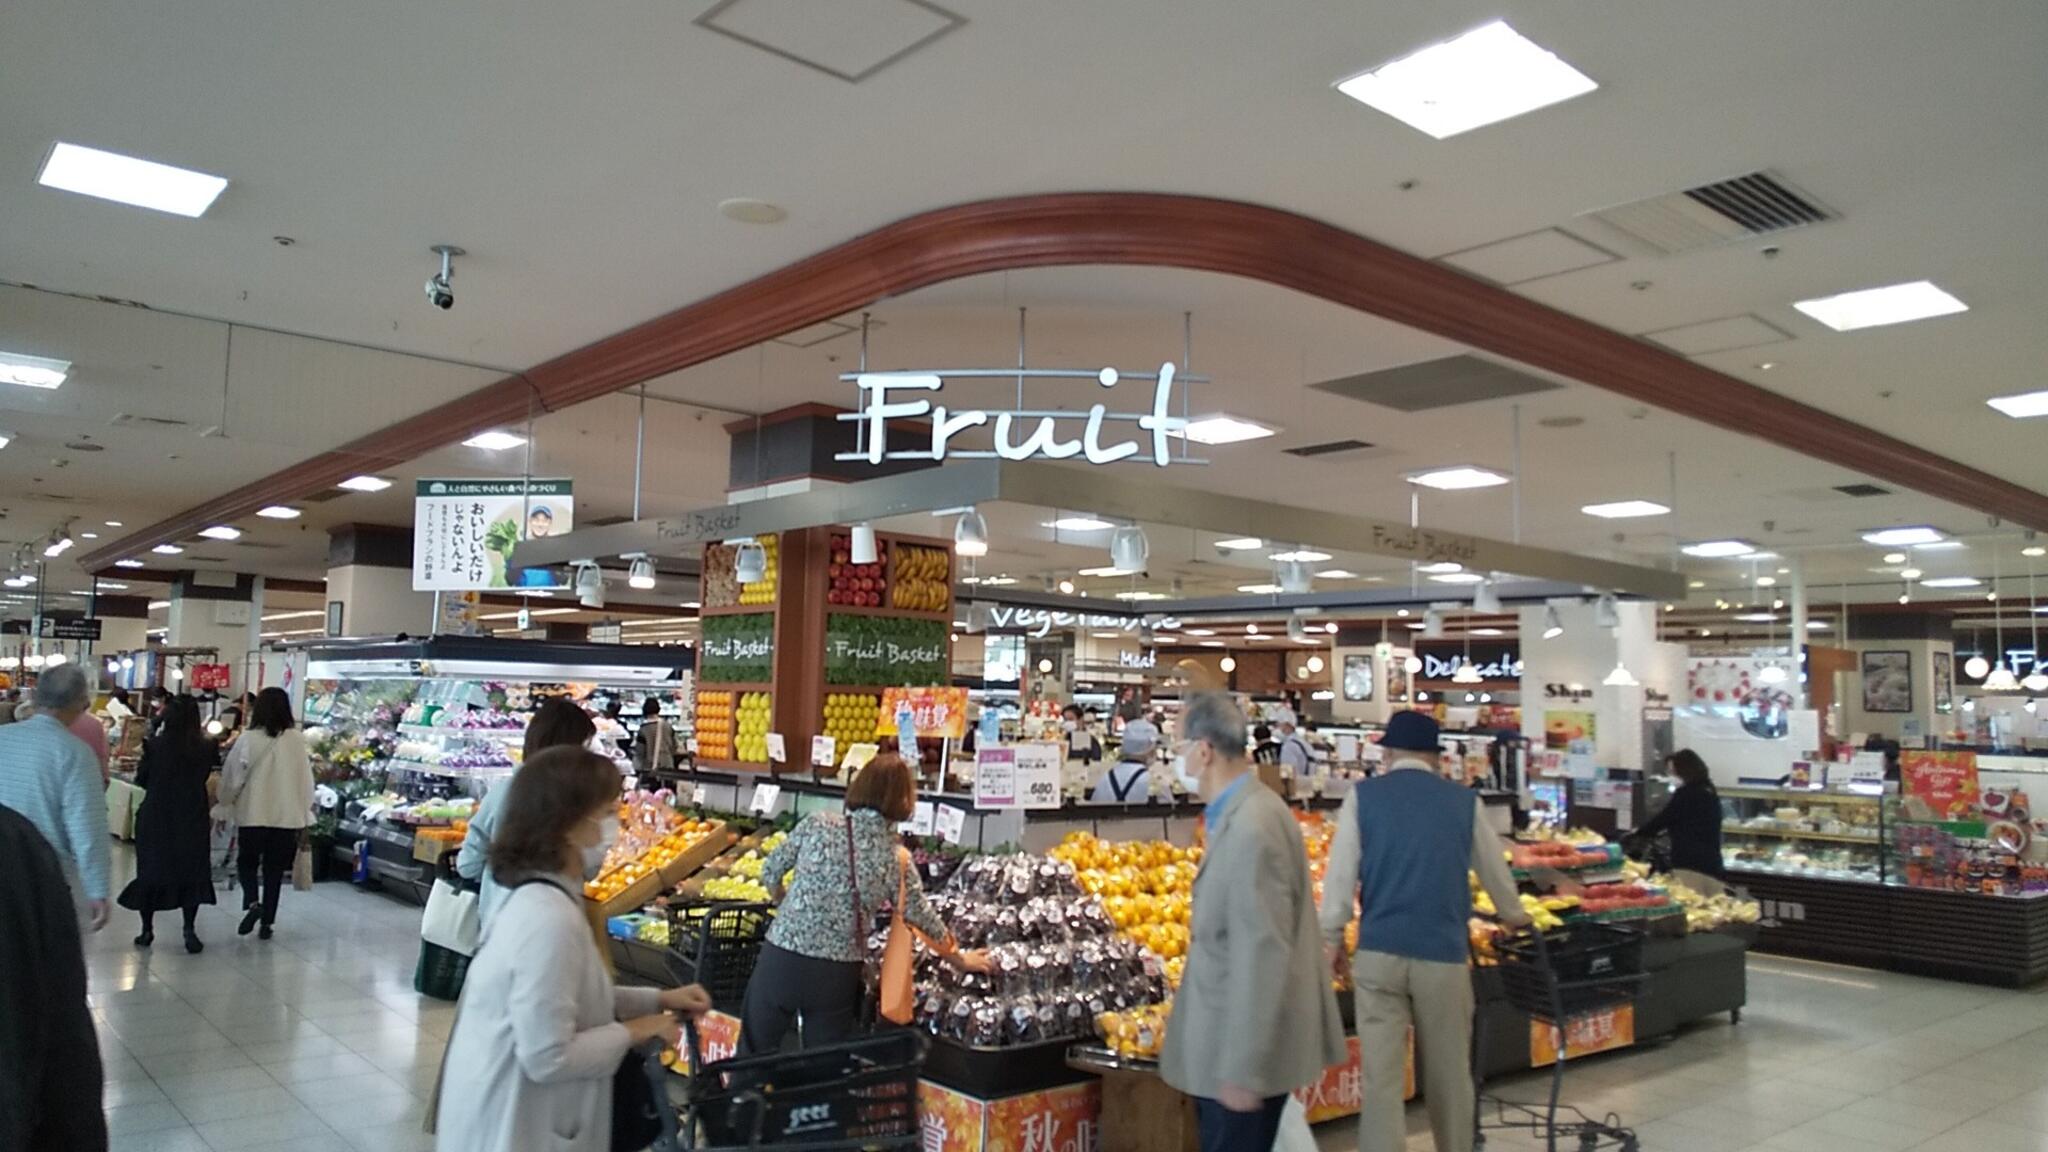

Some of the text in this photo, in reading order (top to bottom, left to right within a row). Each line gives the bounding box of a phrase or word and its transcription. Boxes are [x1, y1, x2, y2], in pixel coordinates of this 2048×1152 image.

[857, 361, 1189, 467] Fruit
[451, 503, 465, 574] じゃないんよ
[657, 505, 741, 540] Fruit Basket
[469, 502, 486, 583] おいしいだけ
[1372, 525, 1478, 561] Fruit Basket
[704, 635, 771, 661] Fruit Basket
[835, 640, 941, 664] Fruit Basket
[1119, 649, 1157, 669] Meat
